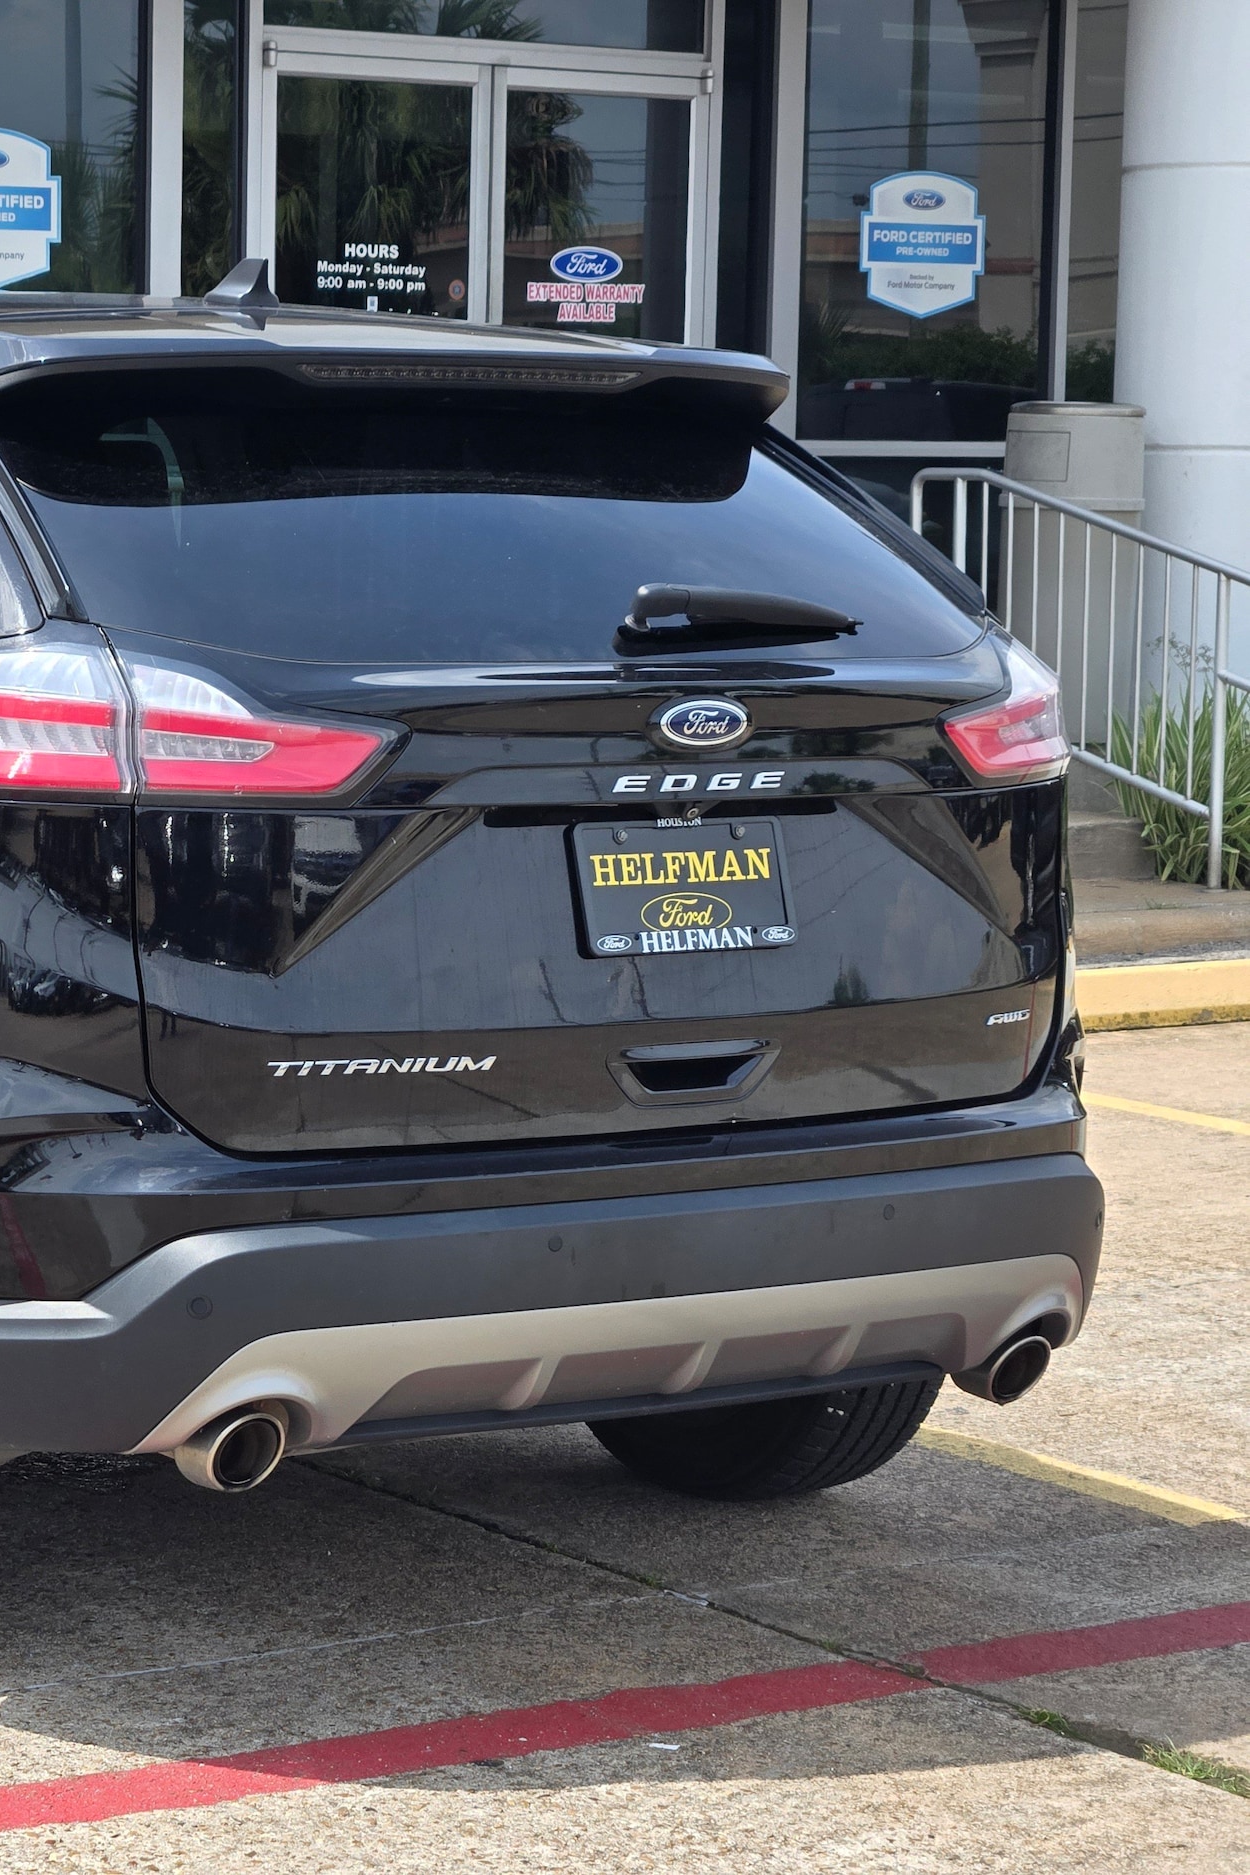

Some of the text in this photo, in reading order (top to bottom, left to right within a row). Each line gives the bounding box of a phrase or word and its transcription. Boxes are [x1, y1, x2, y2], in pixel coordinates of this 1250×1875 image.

[910, 192, 937, 207] Ford
[873, 229, 972, 245] FORD CERTIFIED
[344, 243, 400, 259] HOURS
[895, 246, 950, 257] PRE-OWNED
[317, 260, 364, 276] Monday
[373, 262, 426, 279] Saturday
[565, 252, 608, 275] Ford
[317, 276, 343, 289] 9:00
[347, 279, 367, 289] am
[377, 278, 404, 290] 9:00
[406, 280, 426, 293] pm
[527, 282, 645, 303] EXTENDED WARRANTY
[887, 280, 956, 290] Ford Motor Company
[557, 302, 616, 322] AVAILABLE
[683, 709, 730, 735] Ford
[612, 771, 786, 793] EDGE
[589, 847, 771, 887] HELFMAN
[659, 898, 714, 928] Ford
[639, 926, 754, 953] HELFMAN
[986, 1008, 1031, 1026] AWD
[266, 1056, 497, 1077] TITANIUM
